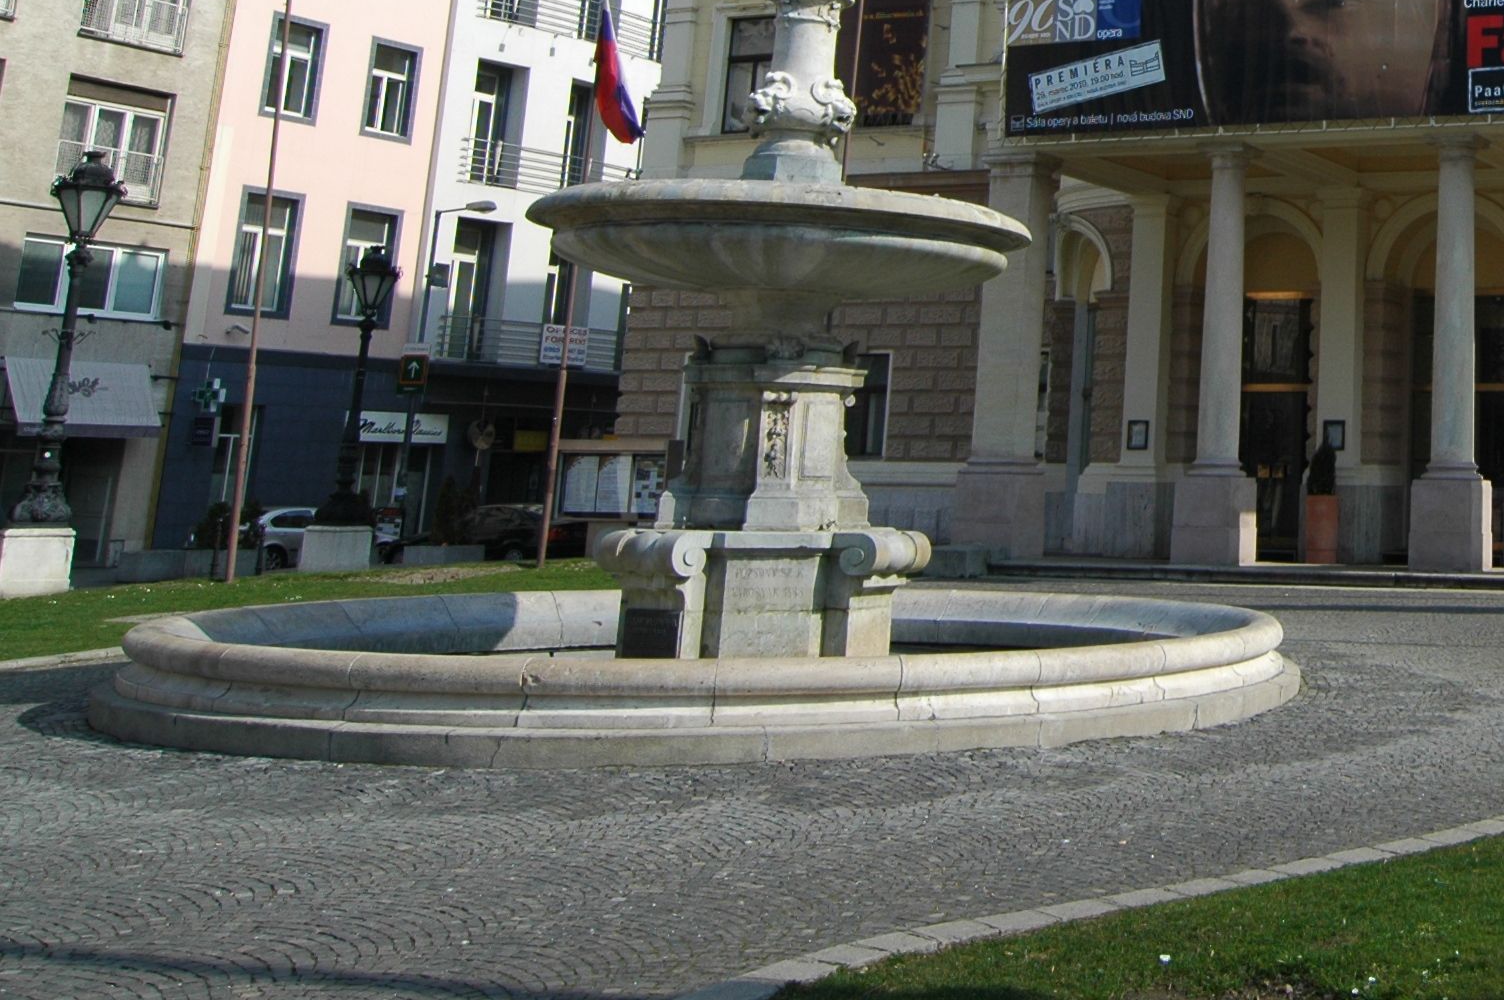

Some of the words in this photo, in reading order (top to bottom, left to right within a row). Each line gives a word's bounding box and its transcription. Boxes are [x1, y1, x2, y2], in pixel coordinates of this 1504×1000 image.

[1097, 28, 1123, 40] opera
[1034, 55, 1125, 89] PREMIÉRA
[1026, 114, 1046, 128] Sála
[1047, 116, 1072, 128] opery
[1072, 115, 1079, 125] a
[1080, 113, 1108, 125] baletu
[1116, 112, 1138, 123] nová
[1139, 109, 1172, 122] budova
[1172, 108, 1194, 121] SND
